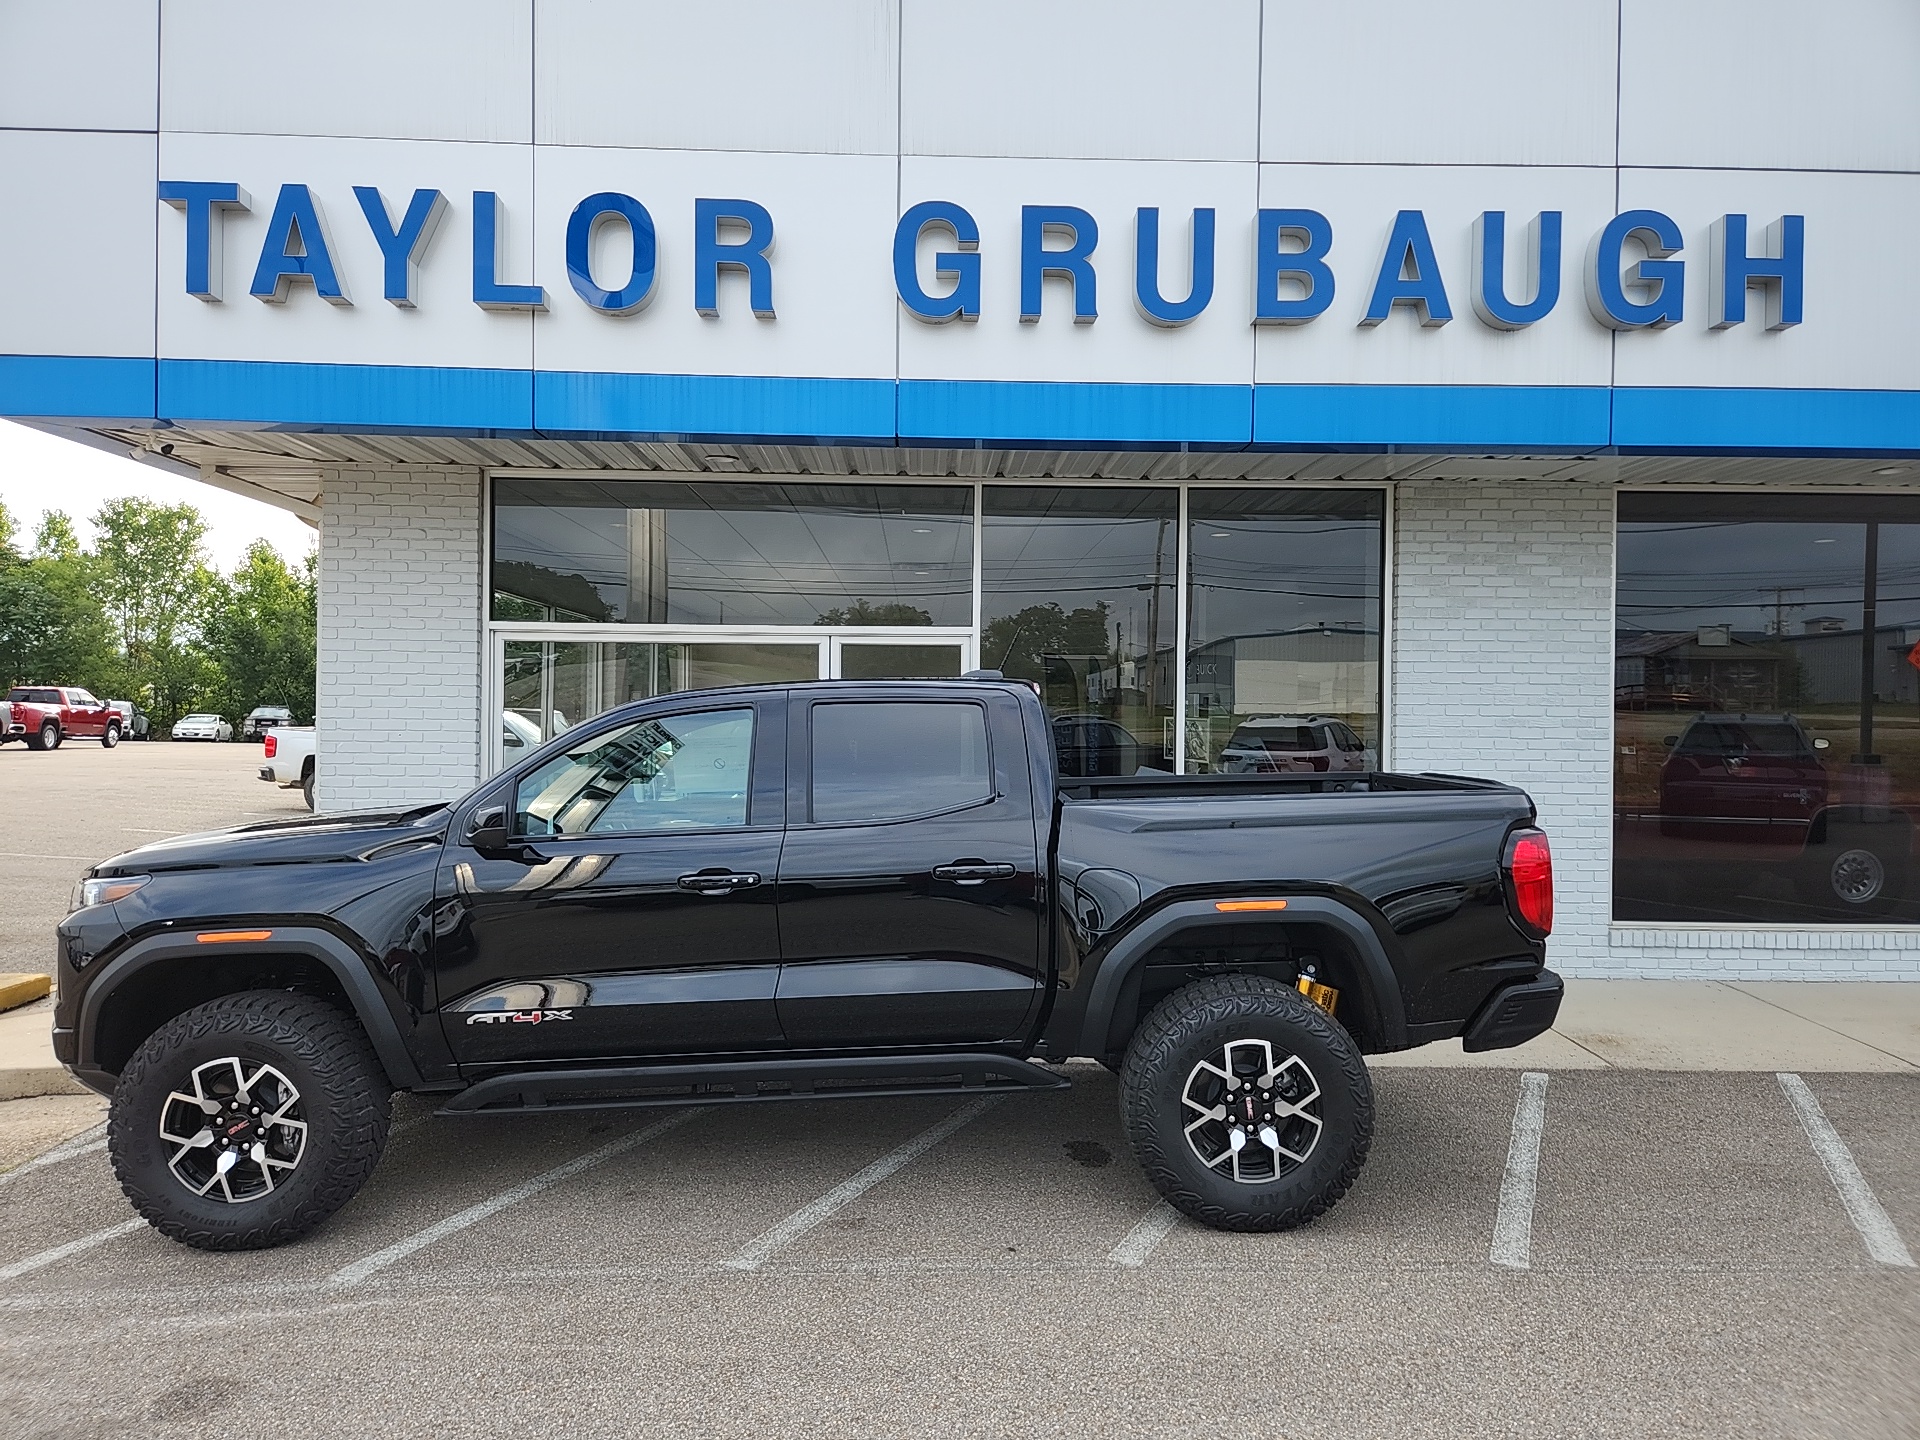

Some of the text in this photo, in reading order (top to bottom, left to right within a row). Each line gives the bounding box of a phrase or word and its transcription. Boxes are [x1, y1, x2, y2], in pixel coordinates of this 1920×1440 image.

[158, 181, 1804, 331] TAYLOR GRUBAUGH
[1196, 663, 1217, 675] BUICK
[466, 1009, 573, 1025] AT4X
[1245, 1096, 1254, 1120] GMC
[227, 1119, 250, 1136] GMC
